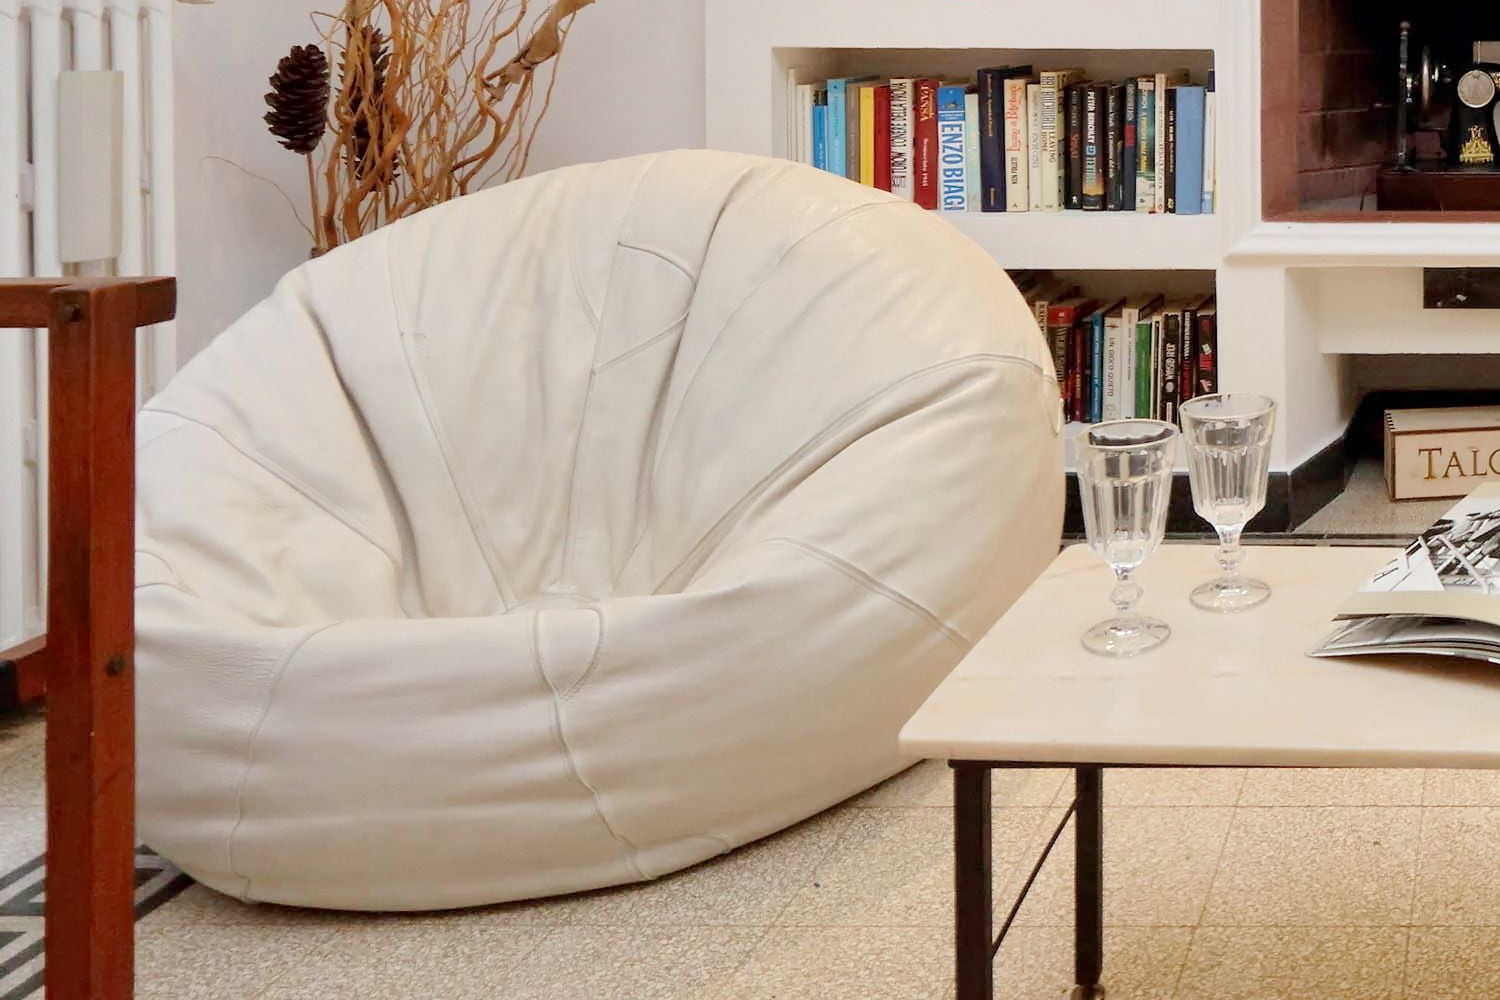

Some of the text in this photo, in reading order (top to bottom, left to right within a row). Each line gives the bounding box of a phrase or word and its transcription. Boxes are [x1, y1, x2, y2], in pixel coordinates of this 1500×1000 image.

[891, 103, 906, 121] DELLA
[919, 86, 930, 122] PANSA
[1087, 91, 1095, 111] PETER
[891, 152, 905, 174] TUROW
[941, 124, 965, 211] ENZO BIAGI
